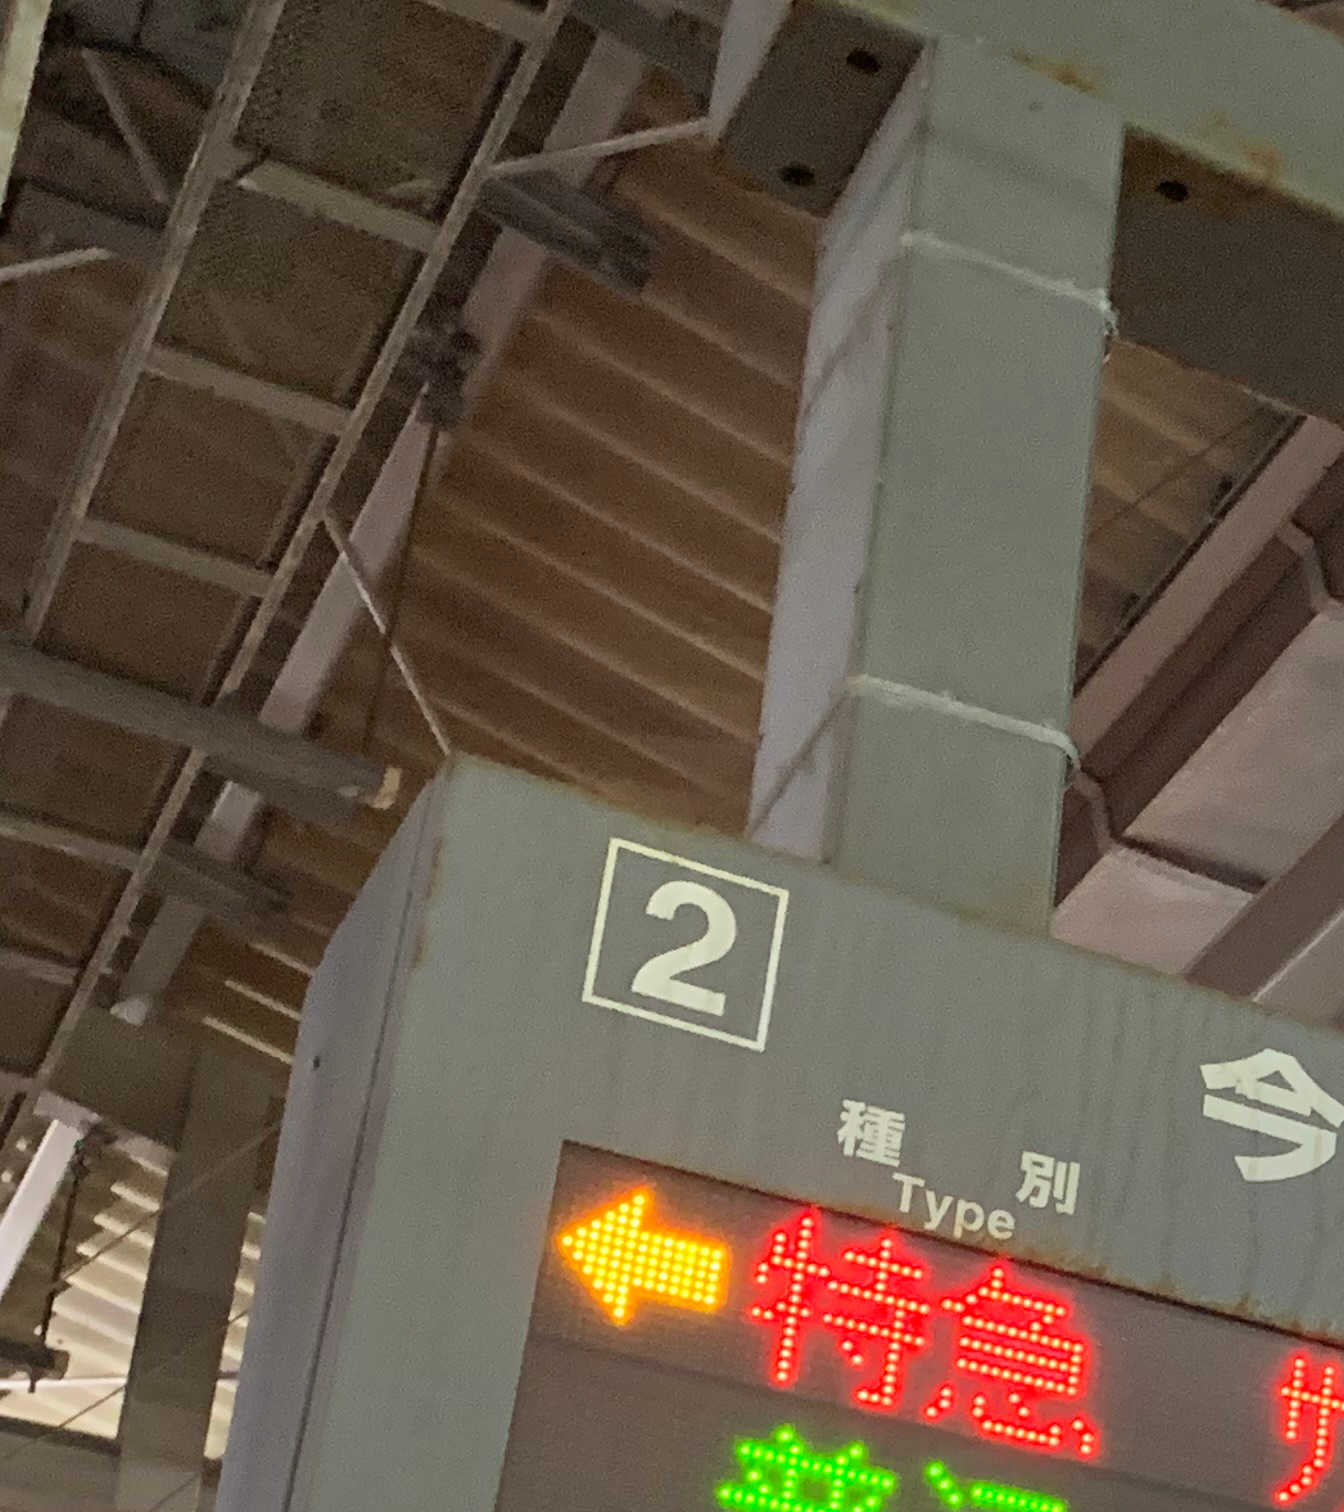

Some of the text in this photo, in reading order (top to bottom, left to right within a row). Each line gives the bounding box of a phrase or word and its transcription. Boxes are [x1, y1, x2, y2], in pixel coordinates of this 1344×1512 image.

[632, 880, 737, 1016] 2
[837, 1100, 1081, 1215] 種別
[892, 1172, 1016, 1241] Type
[752, 1210, 1097, 1458] 特急
